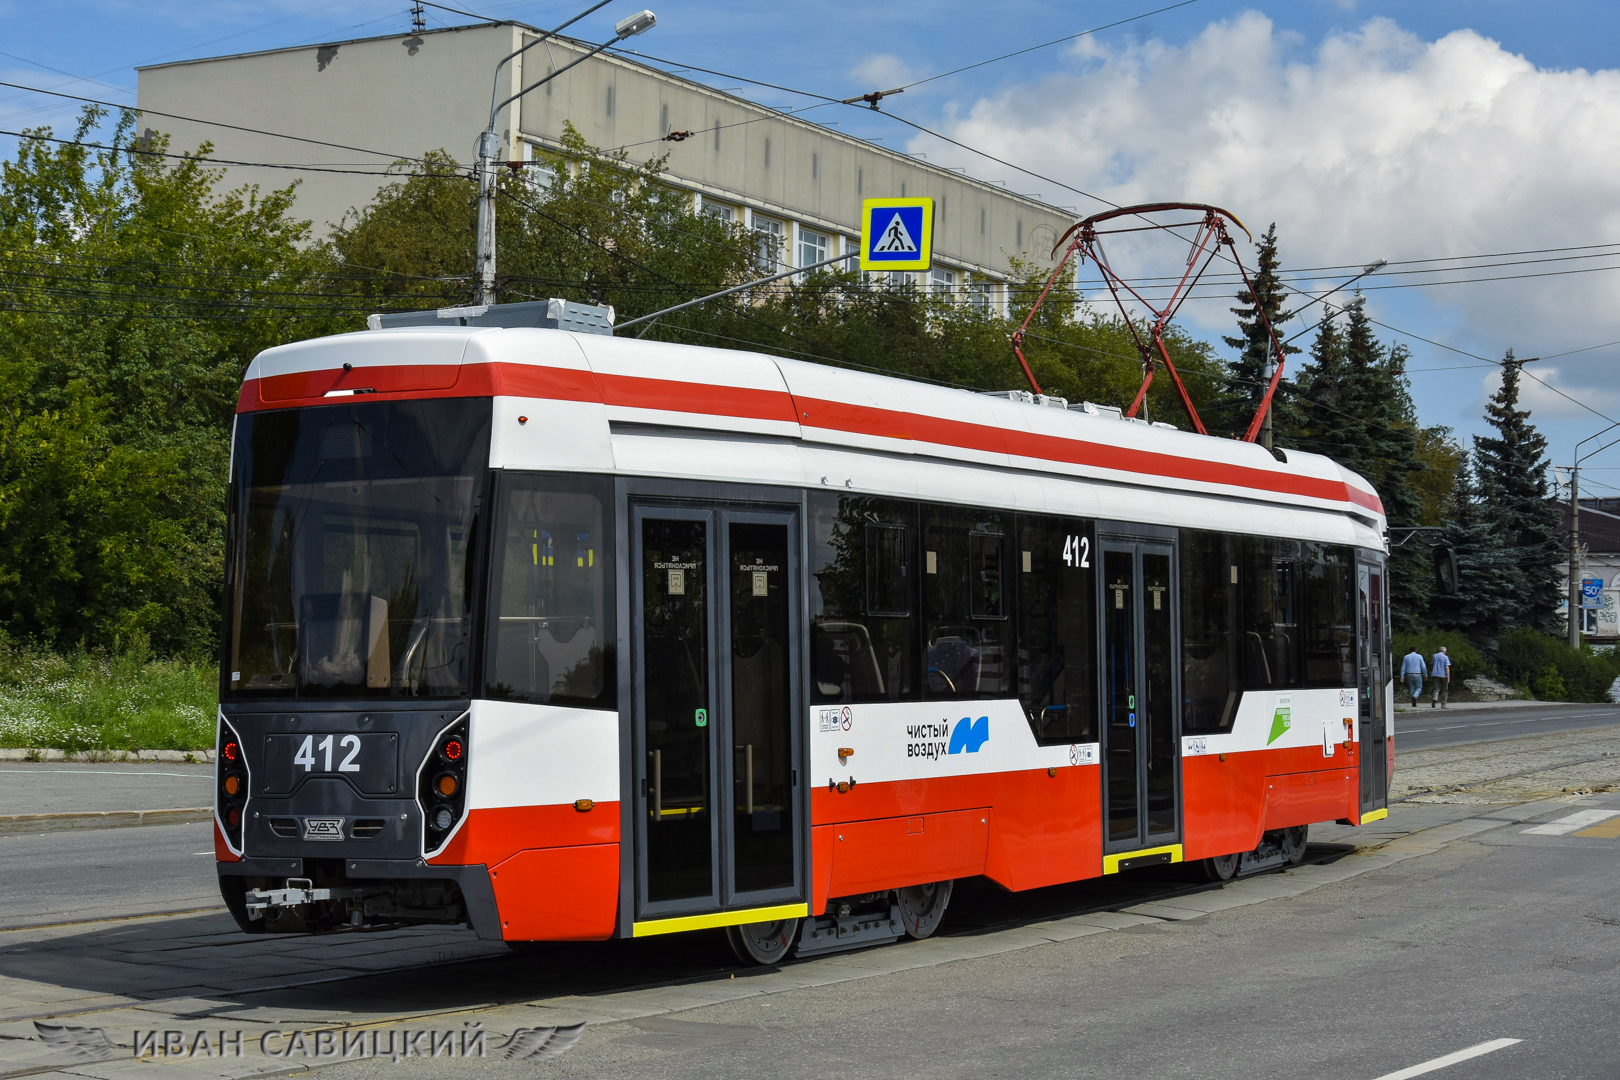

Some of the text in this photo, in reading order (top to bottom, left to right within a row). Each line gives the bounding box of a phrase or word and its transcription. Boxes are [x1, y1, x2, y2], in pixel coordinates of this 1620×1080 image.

[1062, 534, 1090, 568] 412
[907, 718, 949, 739] ЧИСТЫЙ
[294, 734, 361, 772] 412
[907, 742, 947, 761] ВОЗДУХ
